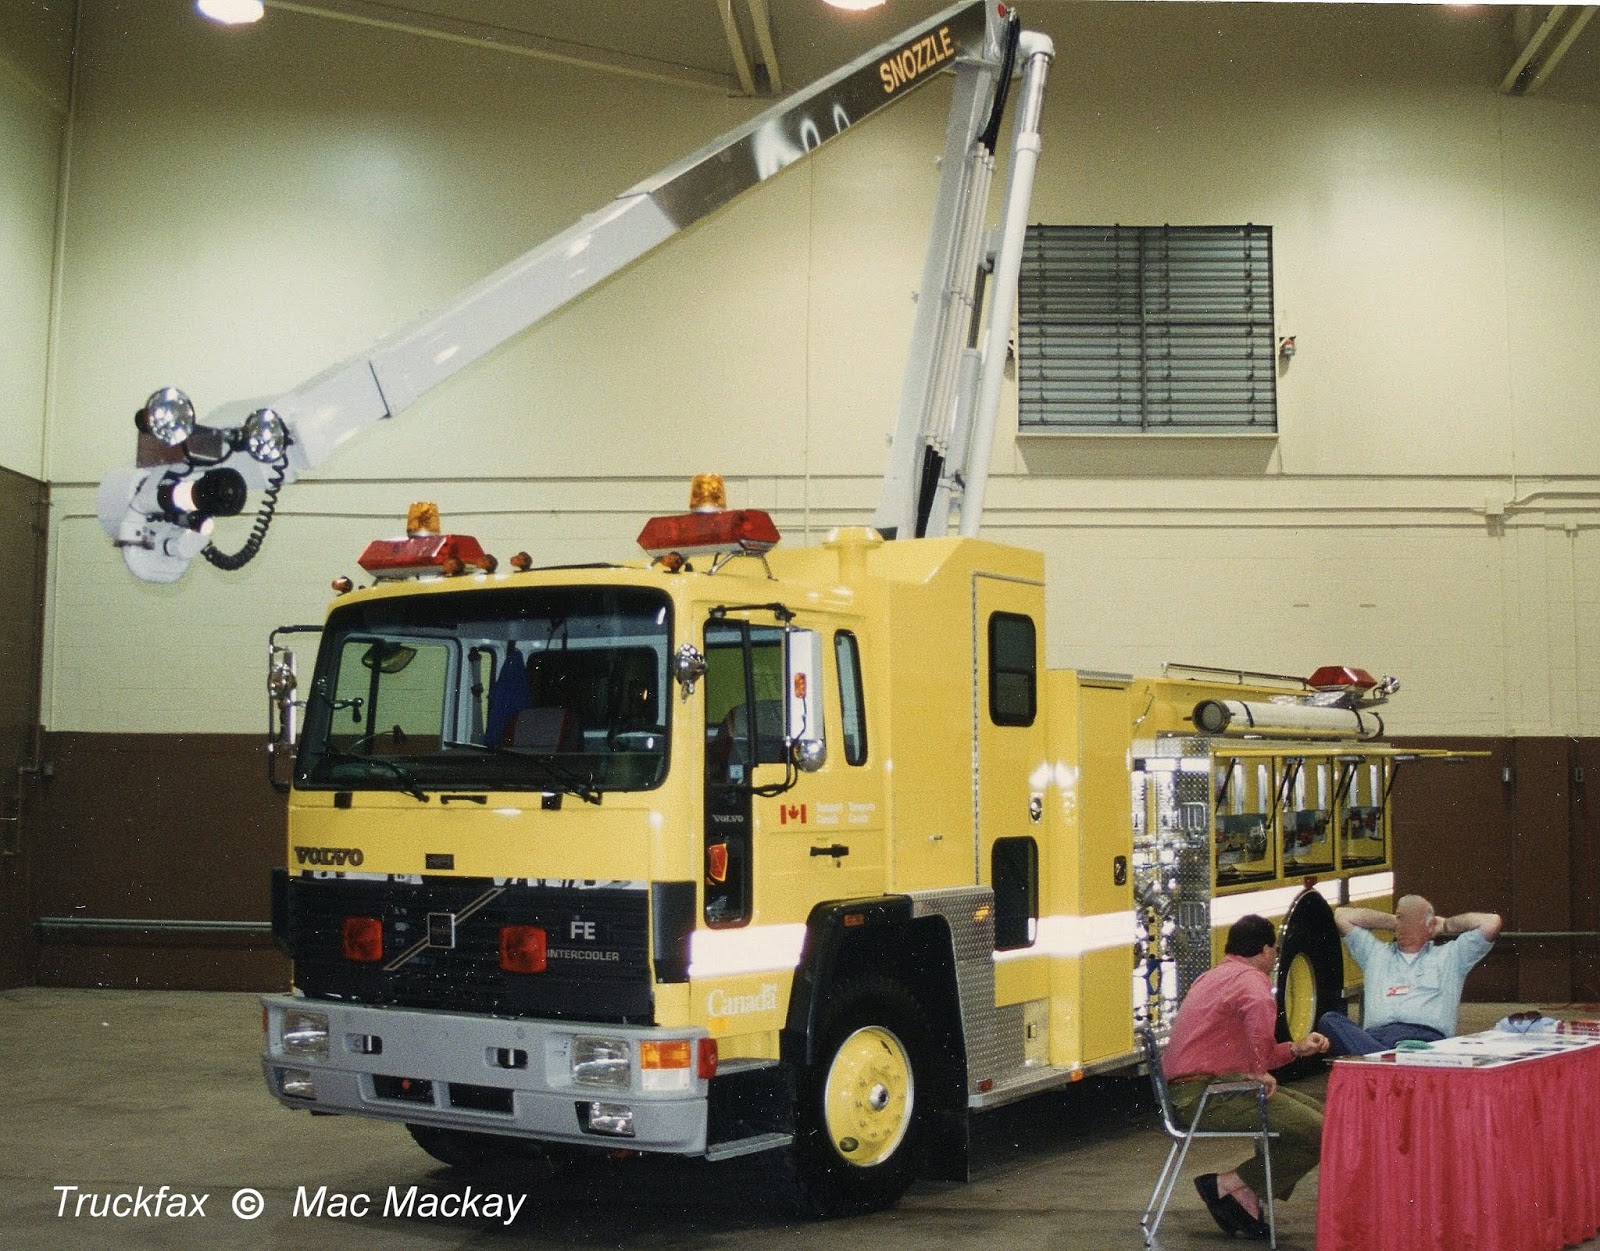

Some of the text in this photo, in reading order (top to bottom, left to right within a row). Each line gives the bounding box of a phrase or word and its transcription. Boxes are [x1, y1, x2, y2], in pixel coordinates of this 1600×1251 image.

[879, 27, 955, 94] SNOZZLE
[712, 813, 745, 823] VOLVO
[294, 846, 364, 867] VOLVO
[570, 921, 596, 940] FE
[547, 949, 620, 962] INTERCOOLER
